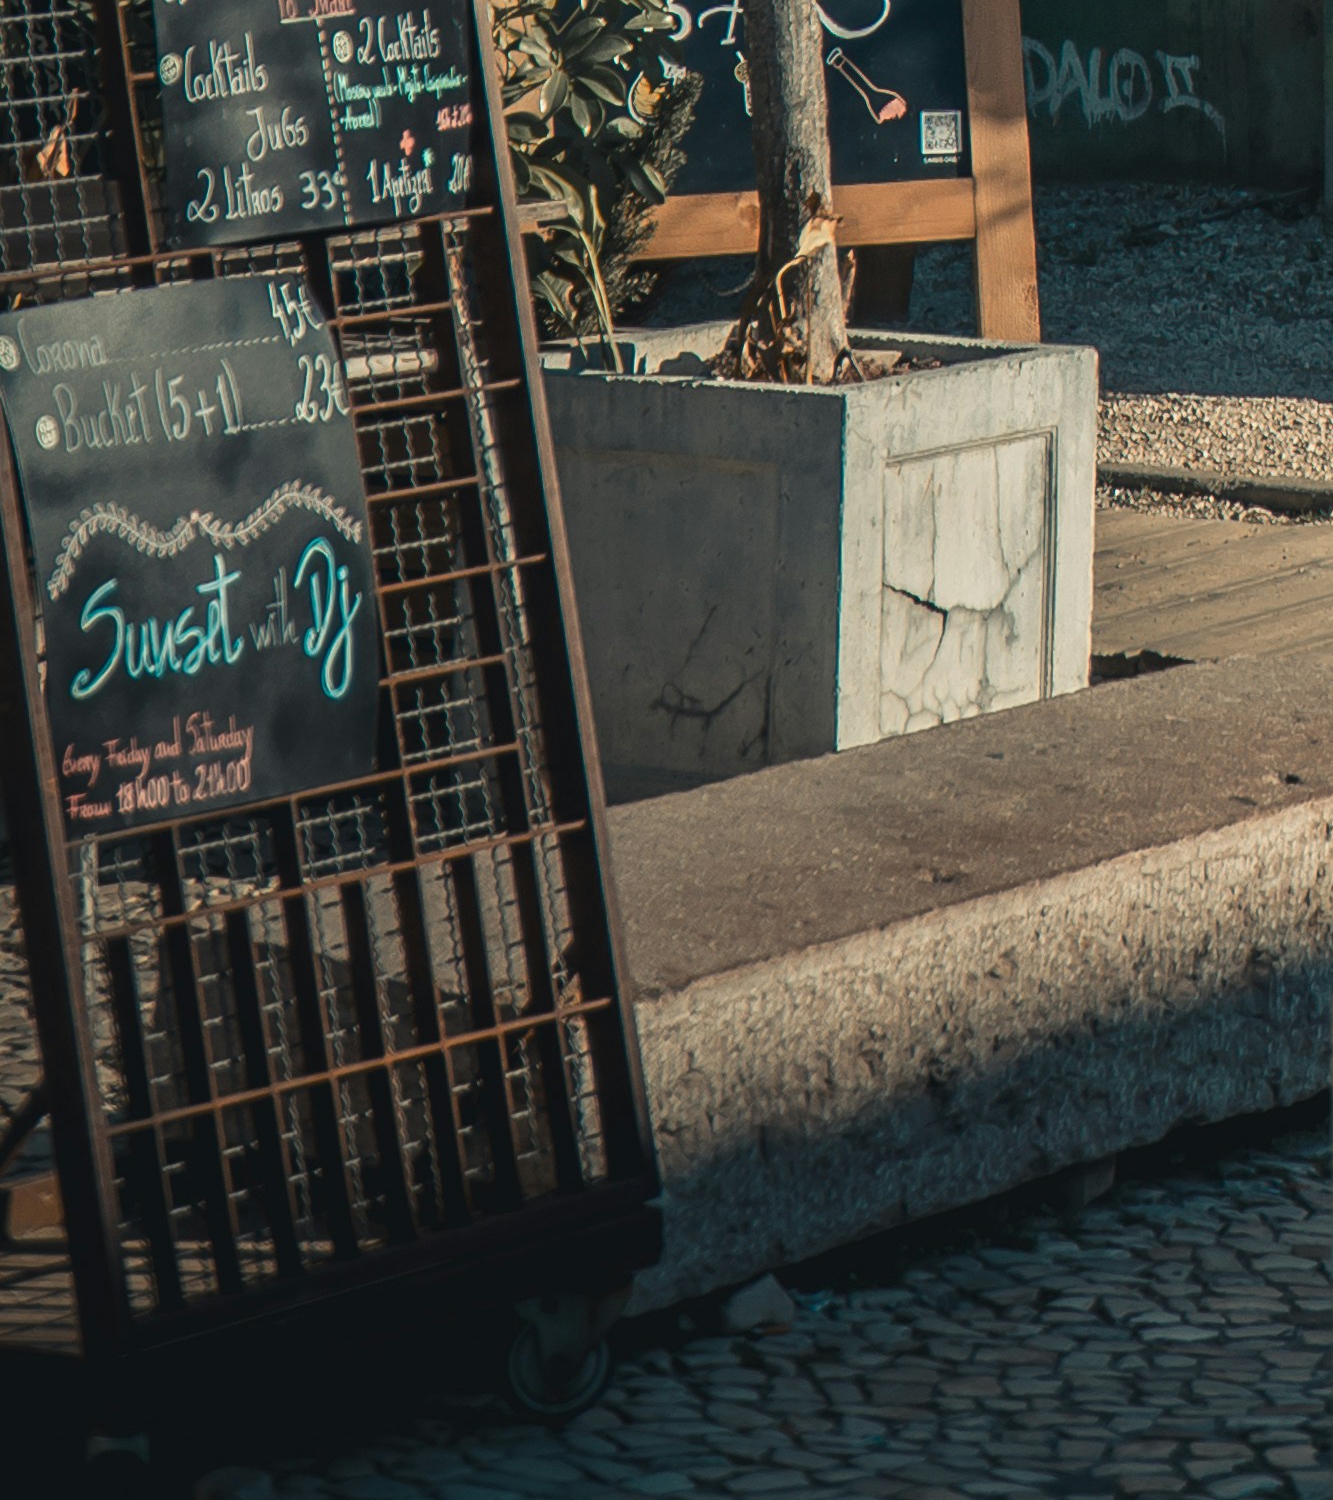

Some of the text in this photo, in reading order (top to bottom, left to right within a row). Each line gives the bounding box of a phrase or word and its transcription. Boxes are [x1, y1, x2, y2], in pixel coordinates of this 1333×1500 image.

[184, 30, 270, 103] Cocktails
[357, 7, 442, 64] 2 Cocktails
[186, 167, 220, 224] 2
[223, 161, 285, 221] Litros
[366, 158, 381, 204] 1
[17, 318, 108, 376] Corona
[52, 370, 152, 454] Bucket
[155, 357, 244, 443] (5+1)
[71, 536, 362, 699] Sunset with Dj
[62, 710, 255, 788] Every Friday and Saturday
[66, 792, 112, 820] From
[116, 774, 171, 814] 18h00
[170, 769, 191, 805] to
